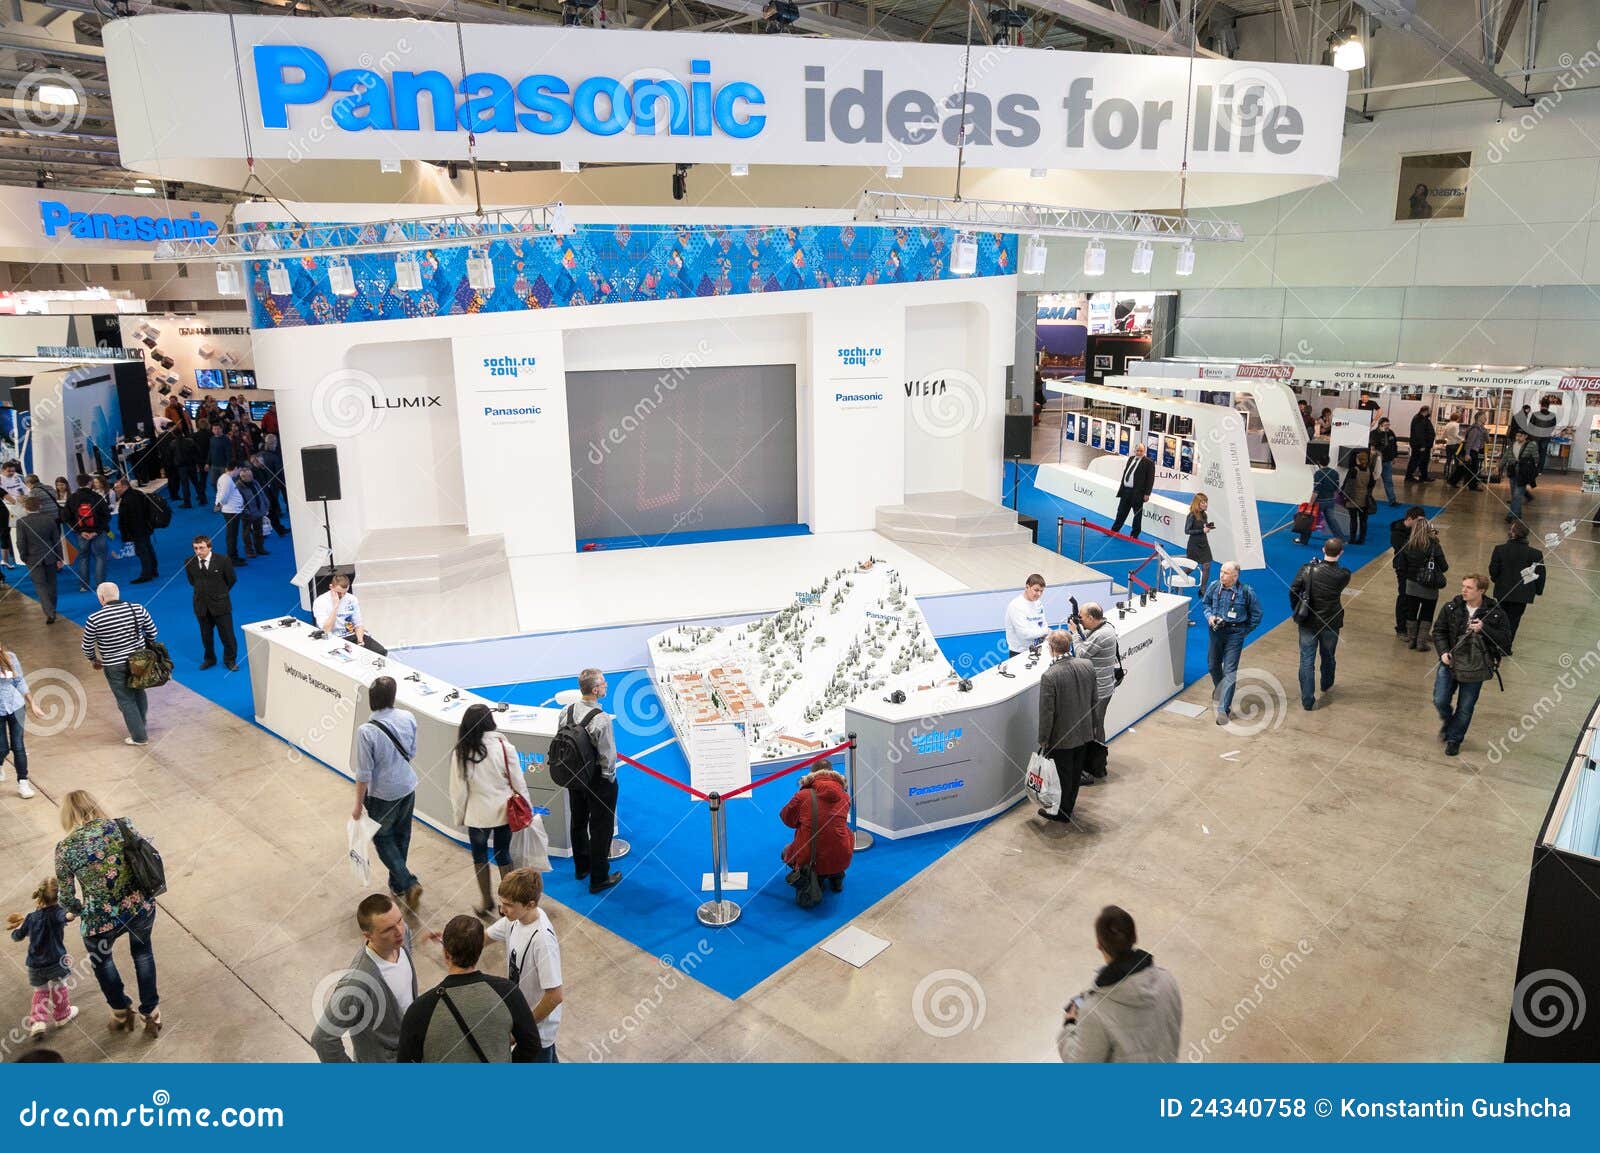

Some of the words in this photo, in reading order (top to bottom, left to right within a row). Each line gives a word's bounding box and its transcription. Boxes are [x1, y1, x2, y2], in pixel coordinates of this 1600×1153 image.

[251, 44, 767, 140] Panasonic
[804, 65, 1041, 148] ideas
[1063, 77, 1173, 151] for
[1193, 84, 1304, 155] life
[39, 200, 218, 245] Panasonic
[837, 346, 882, 357] sochi.ru
[483, 355, 536, 367] sochi.ru
[1492, 377, 1551, 386] ПОТРЕБИТЕЛЬ
[371, 395, 442, 409] LUMIX
[835, 391, 884, 402] Panasonic
[484, 405, 542, 416] Panasonic
[1143, 509, 1163, 524] UMIX
[908, 778, 965, 797] Panasonic
